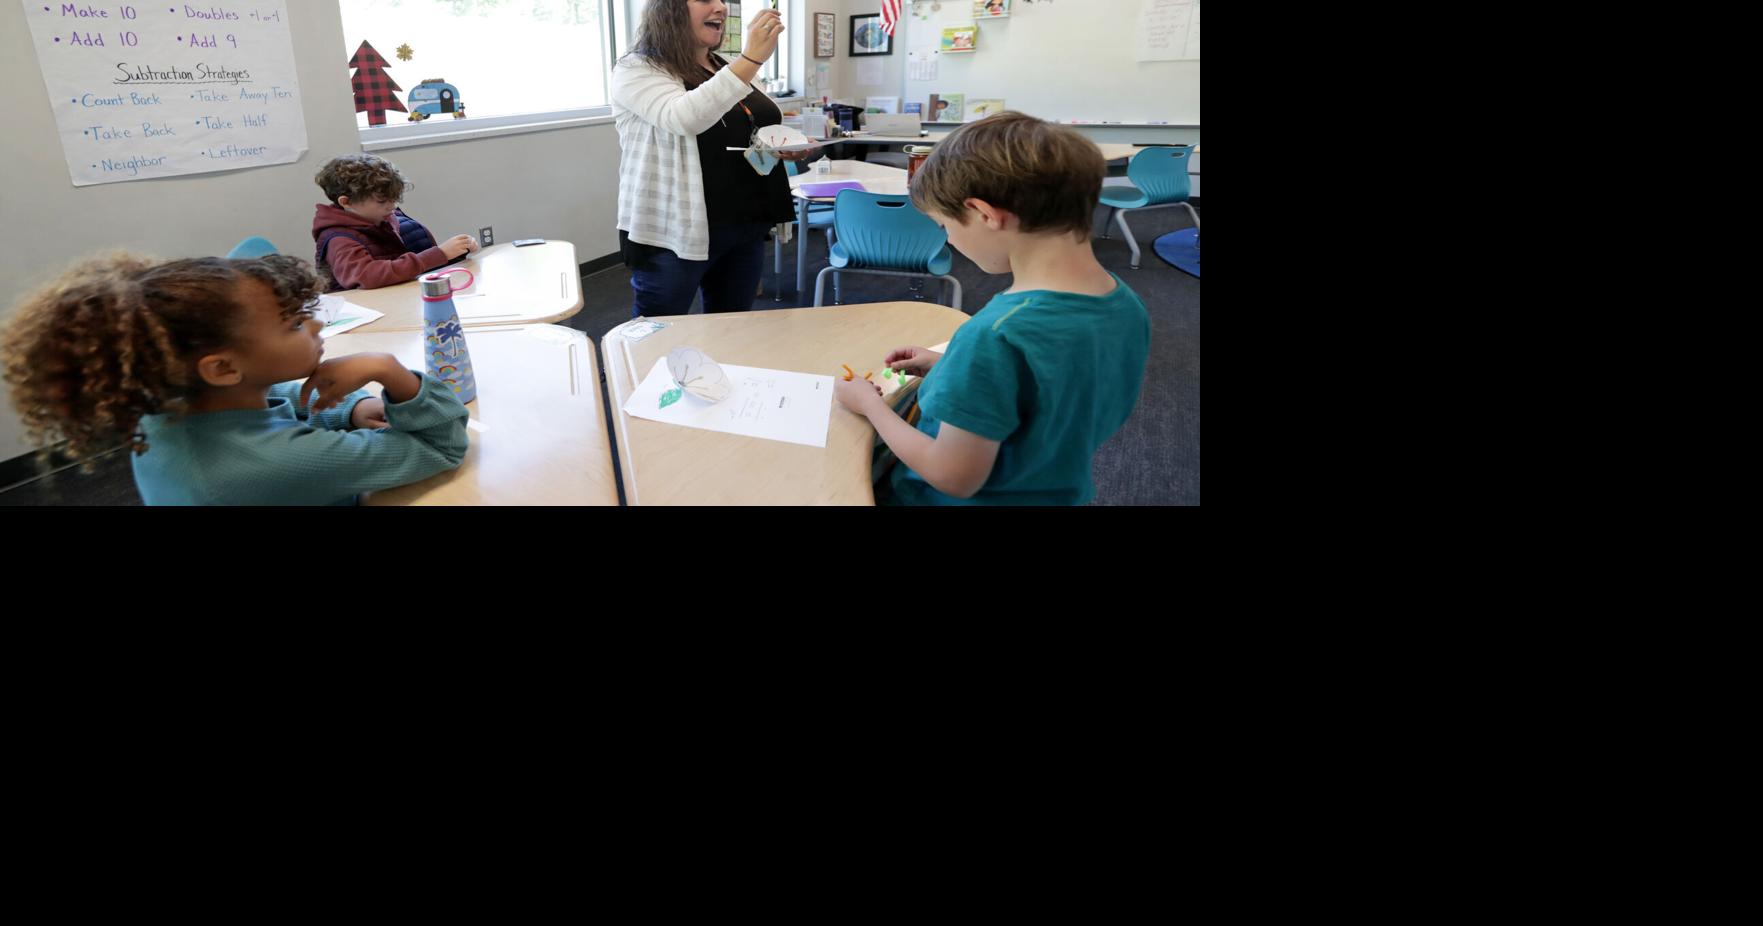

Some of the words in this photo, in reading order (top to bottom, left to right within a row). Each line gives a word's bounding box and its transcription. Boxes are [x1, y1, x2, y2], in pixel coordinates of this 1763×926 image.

[62, 3, 108, 18] Make
[120, 6, 136, 20] 10
[184, 4, 239, 20] Doubles
[70, 31, 105, 47] Add
[120, 31, 138, 47] 10
[190, 33, 217, 48] Add
[226, 34, 237, 48] 9
[114, 62, 193, 82] Subtraction
[196, 62, 250, 85] Strategies
[81, 93, 124, 108] Count
[130, 92, 162, 105] Back
[195, 89, 229, 102] Take
[240, 87, 268, 104] Away
[271, 86, 293, 98] Ten
[200, 115, 234, 130] Take
[242, 113, 267, 127] Half
[88, 126, 132, 140] Take
[142, 122, 176, 138] Back
[208, 144, 267, 159] Leftover
[101, 155, 166, 176] Neighbor
